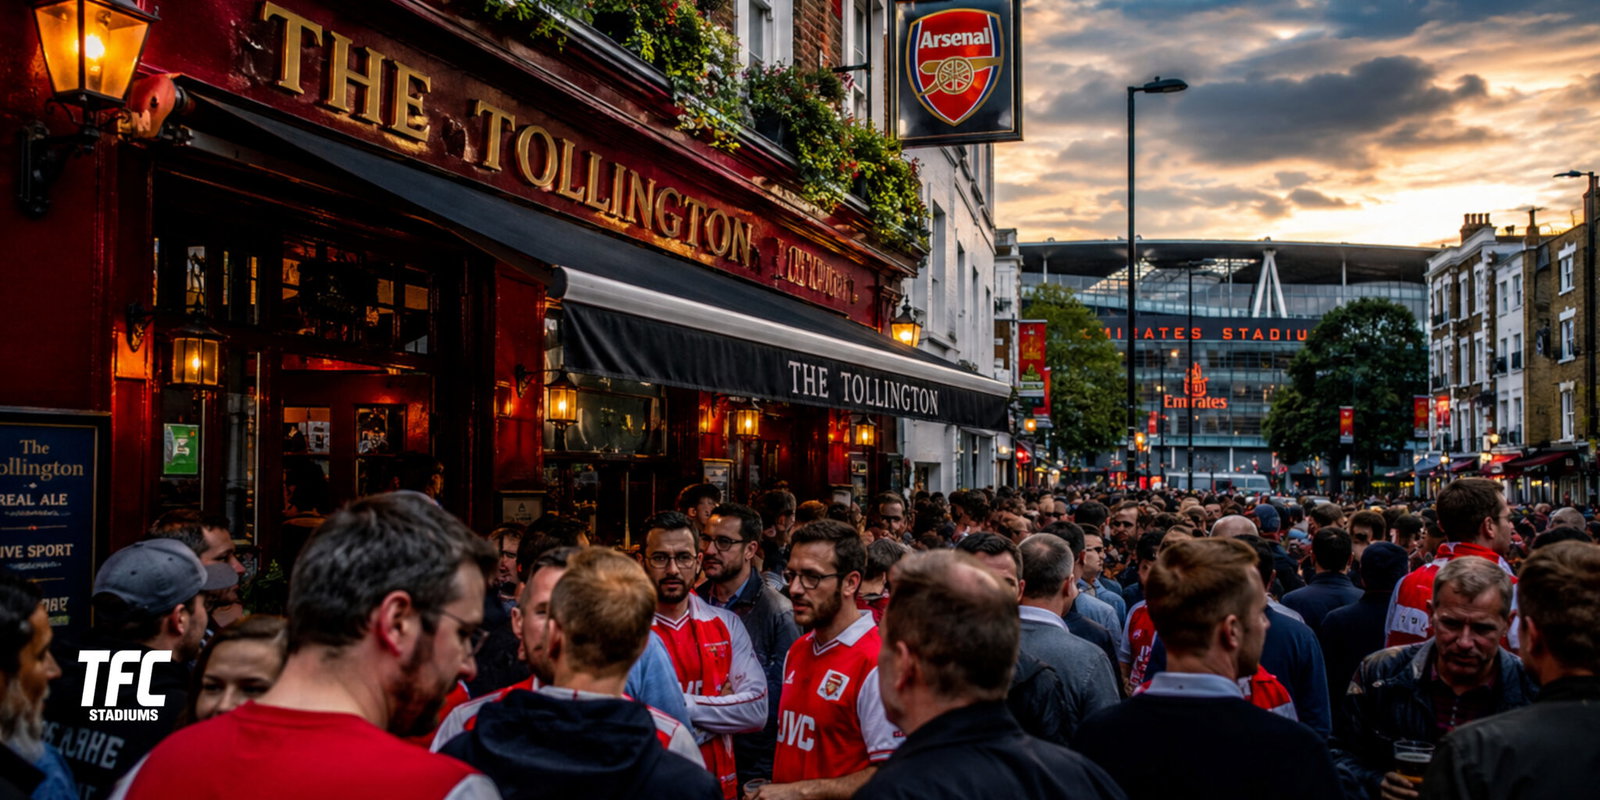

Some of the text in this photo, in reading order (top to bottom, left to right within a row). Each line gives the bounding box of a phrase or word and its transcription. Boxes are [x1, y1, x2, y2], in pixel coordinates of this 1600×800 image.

[920, 27, 990, 48] Arsenal
[264, 1, 754, 267] THE TOLLINGTON
[1222, 327, 1308, 341] STADIU
[788, 360, 939, 416] THE TOLLINGTON
[1164, 394, 1228, 409] Emrates
[20, 440, 50, 454] The
[0, 457, 84, 481] ollington
[0, 493, 68, 506] REAL ALE
[0, 544, 74, 558] IVE SPORT
[777, 710, 815, 751] JVC
